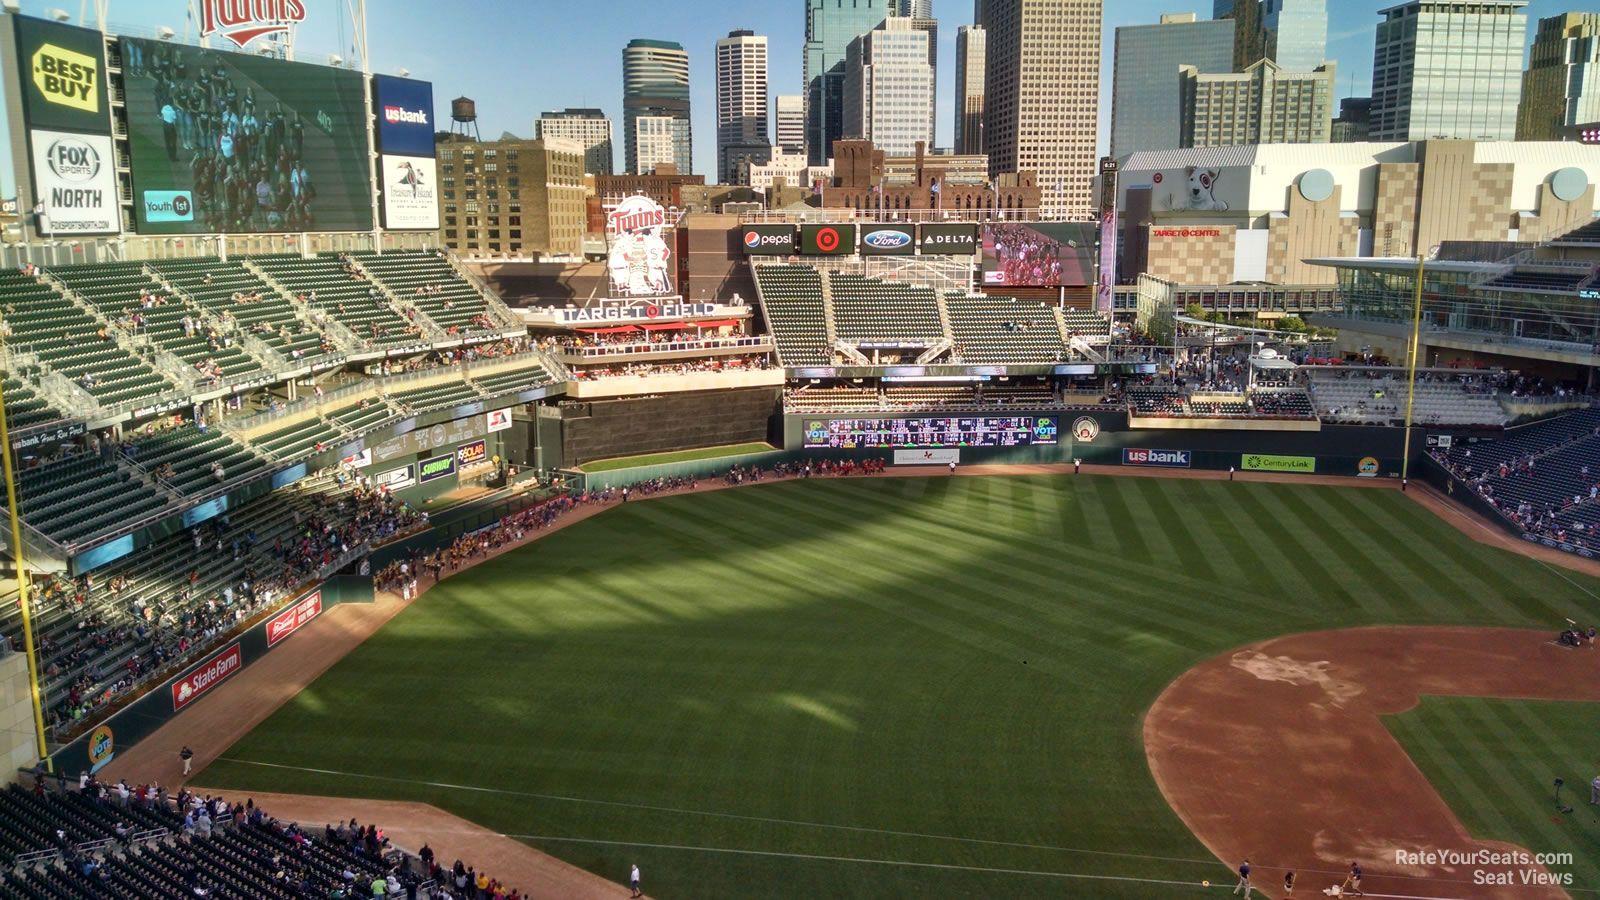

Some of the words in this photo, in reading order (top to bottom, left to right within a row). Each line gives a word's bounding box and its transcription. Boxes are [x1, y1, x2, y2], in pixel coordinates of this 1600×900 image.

[41, 53, 95, 84] BEST
[44, 76, 92, 102] BUY
[58, 145, 89, 166] FOX
[59, 165, 91, 175] SPORTS
[52, 187, 102, 208] NORTH
[147, 200, 172, 212] Youth
[609, 207, 664, 236] Twins
[761, 233, 792, 246] pepsi
[872, 233, 902, 246] Ford
[936, 235, 973, 244] DELTA
[1152, 229, 1181, 237] TARGET
[1189, 229, 1220, 237] CENTER
[564, 305, 645, 322] TARGET
[663, 303, 716, 317] FIELD
[1033, 426, 1057, 435] VOTE
[421, 457, 454, 476] SUBWAY
[1263, 459, 1309, 468] CenturyLink
[91, 738, 113, 757] VOTE
